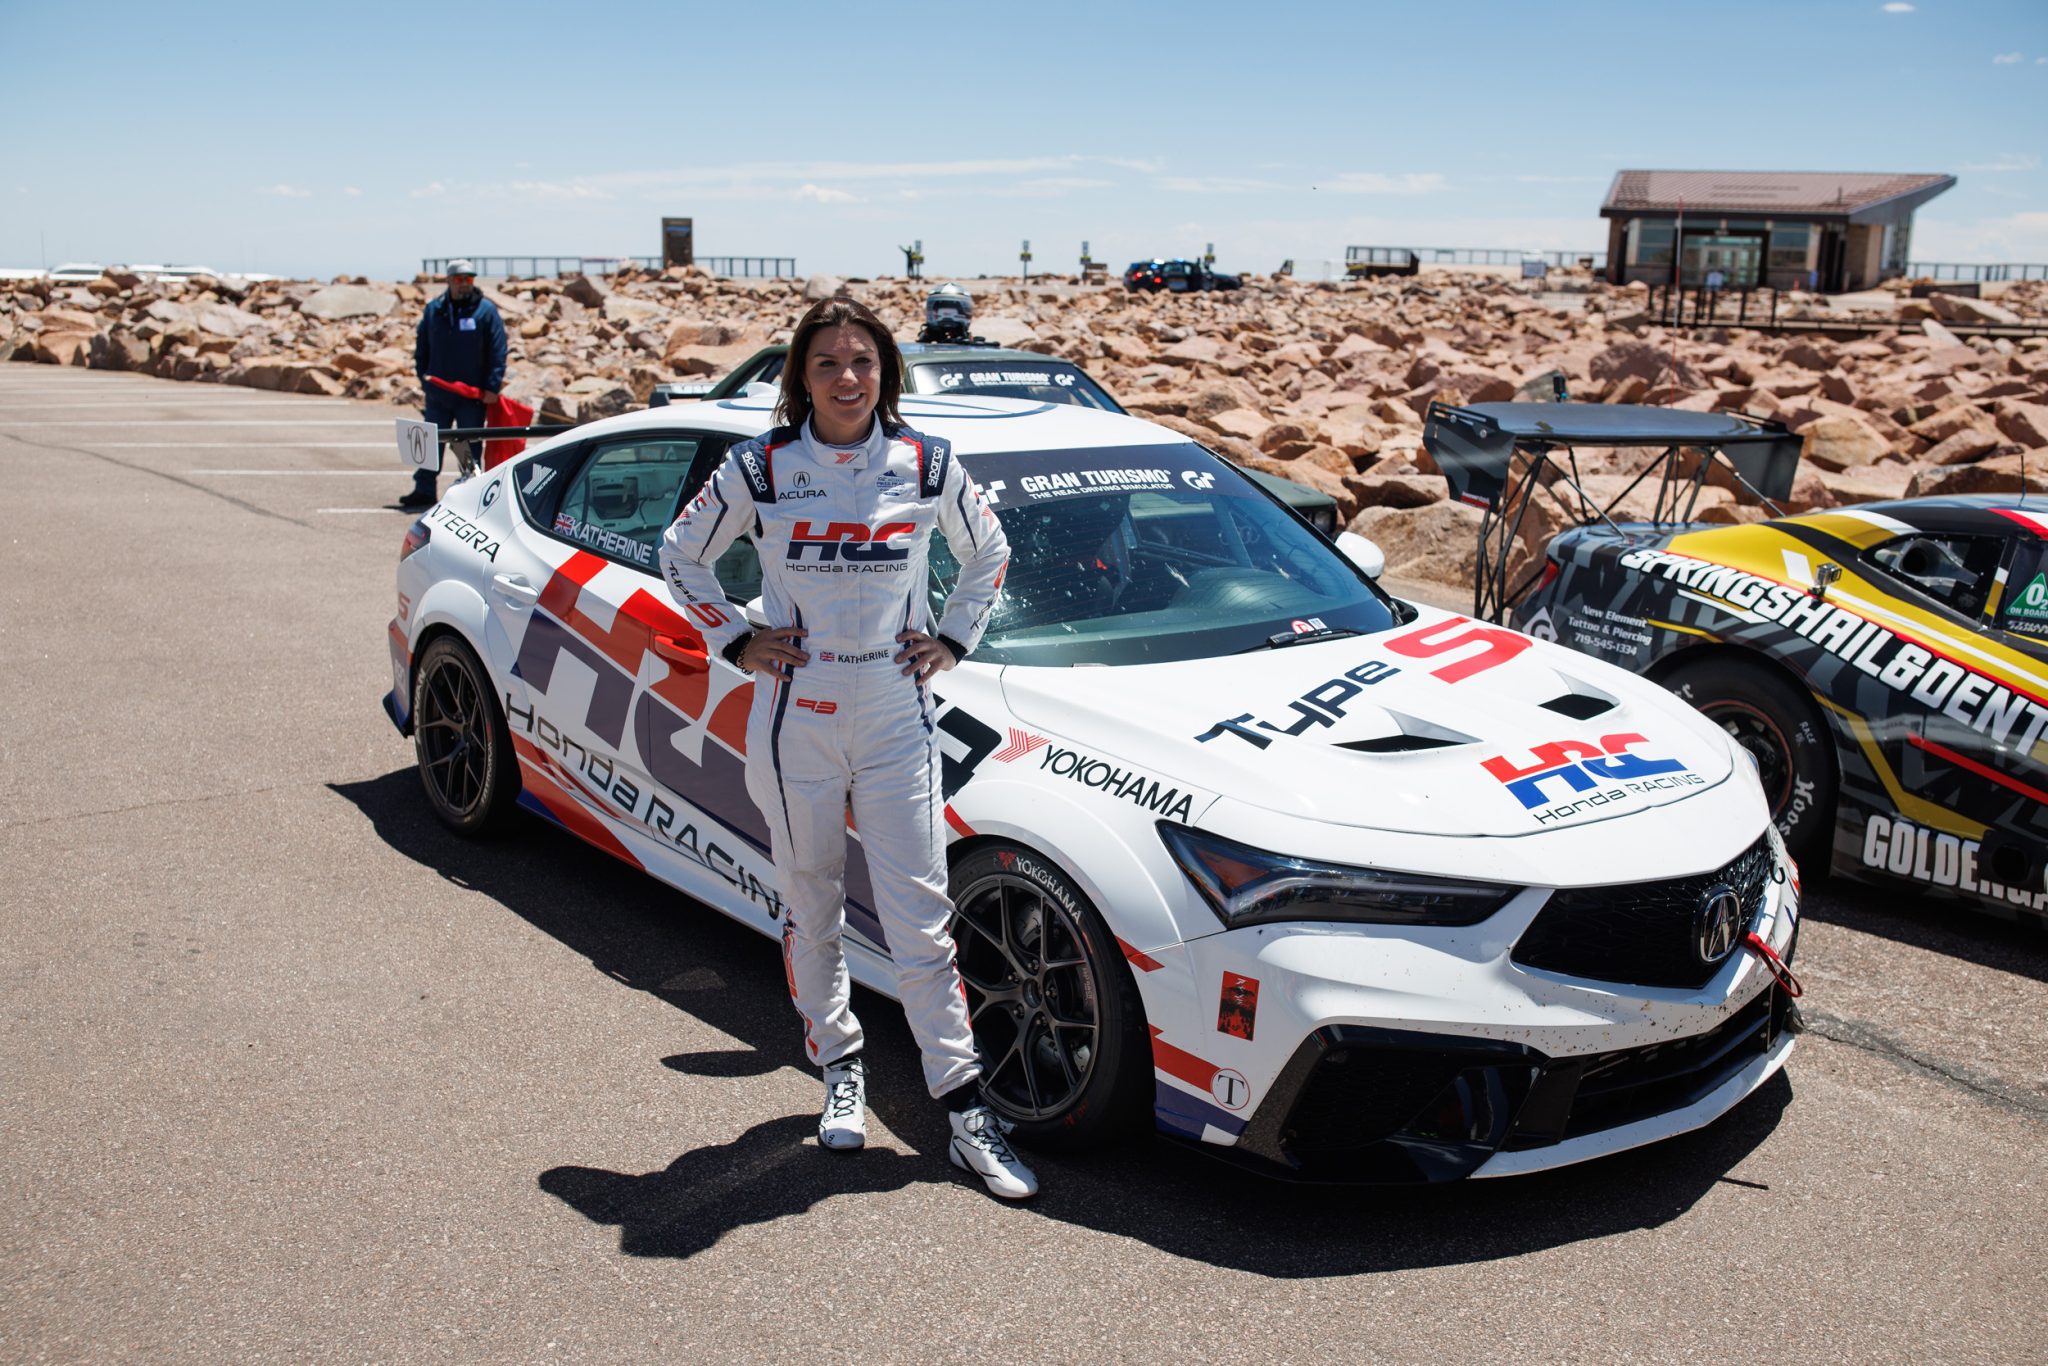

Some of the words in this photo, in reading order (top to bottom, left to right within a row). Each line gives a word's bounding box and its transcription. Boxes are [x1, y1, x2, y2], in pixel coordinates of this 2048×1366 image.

[741, 451, 768, 494] sparco
[928, 446, 943, 488] sparco
[1020, 471, 1082, 493] GRAN
[778, 489, 827, 501] ACURA
[1029, 492, 1053, 500] THE
[1054, 488, 1081, 497] REAL
[1082, 485, 1121, 494] DRIVING
[1122, 482, 1176, 491] SIMULATOR
[570, 521, 653, 565] KATHERINE
[786, 521, 917, 561] HRC
[786, 562, 843, 572] Honda
[847, 562, 908, 573] RACING
[1568, 616, 1600, 633] Tattoo
[1602, 624, 1610, 635] &
[1612, 627, 1653, 646] Piercing
[1582, 604, 1603, 619] New
[1605, 610, 1648, 629] Element
[837, 650, 890, 664] KATHERINE
[1574, 632, 1638, 656] 719-545-1334
[506, 692, 640, 812] Honda
[1039, 744, 1194, 825] YOKOHAMA
[1479, 732, 1689, 811] HRC
[1532, 788, 1628, 825] Honda
[1625, 773, 1706, 796] RACING
[1015, 855, 1083, 925] YOKOHAMA
[1217, 1074, 1245, 1107] T
